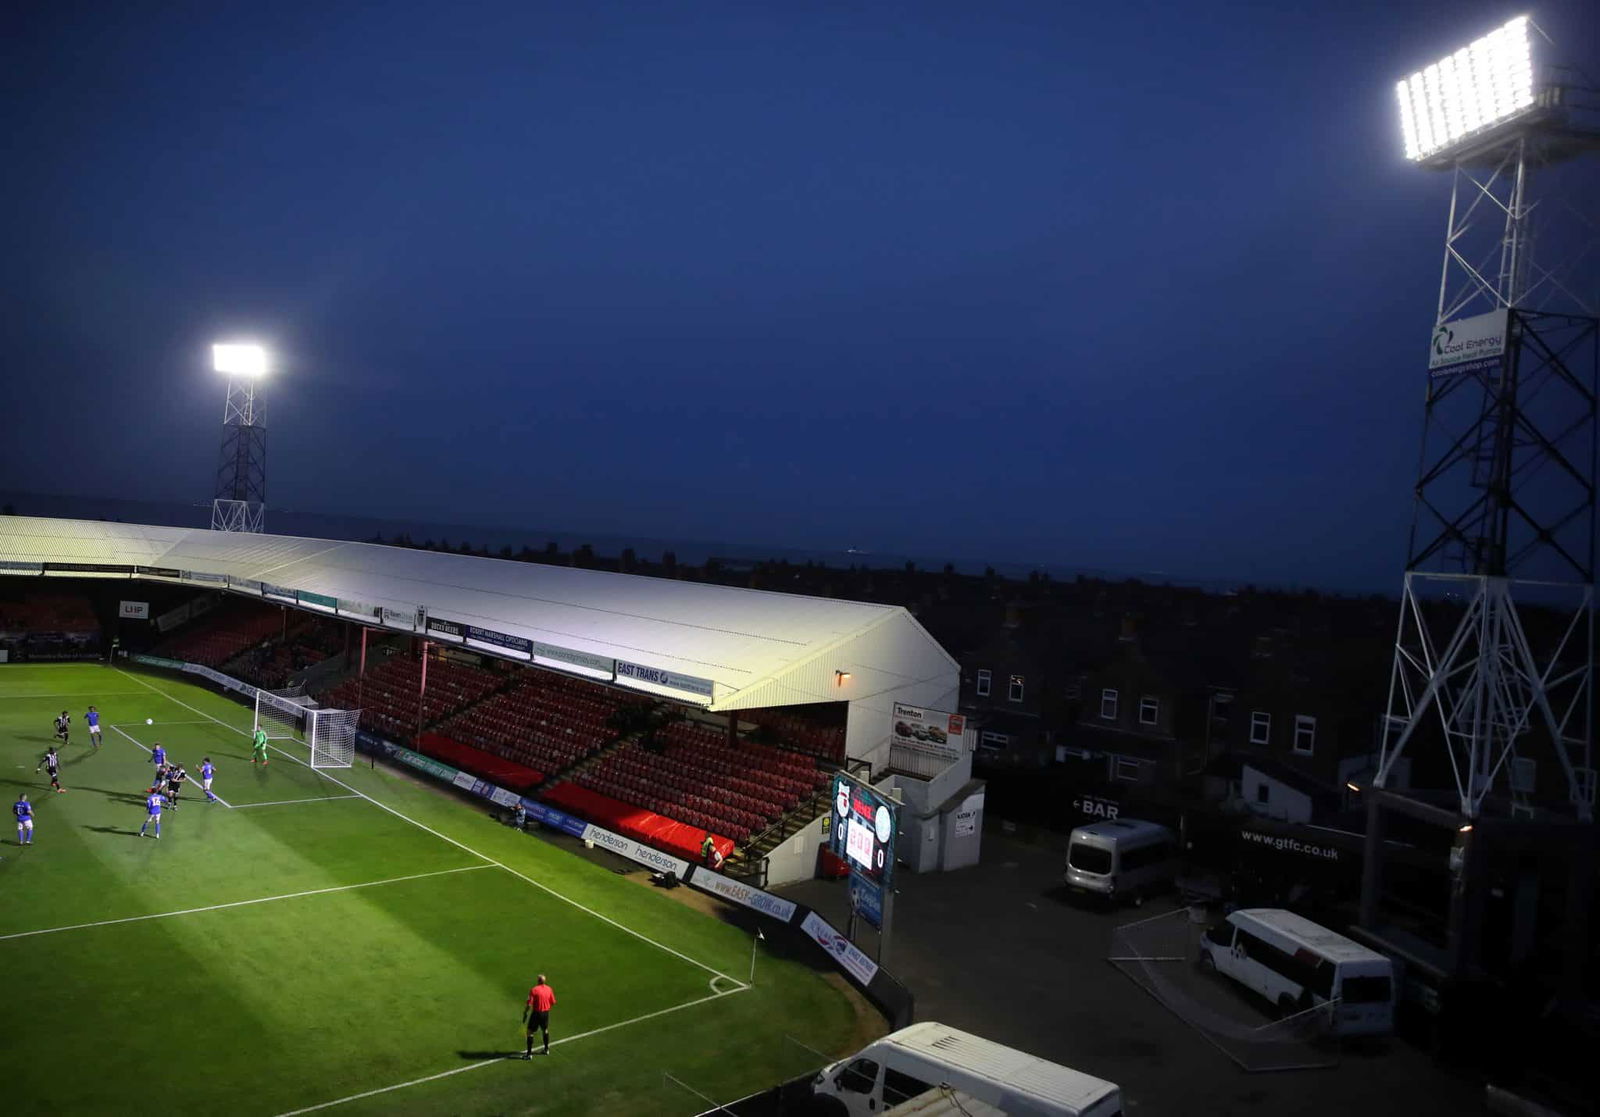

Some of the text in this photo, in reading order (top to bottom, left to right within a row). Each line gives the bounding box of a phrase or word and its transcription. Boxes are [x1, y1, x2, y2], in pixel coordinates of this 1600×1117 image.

[1466, 337, 1501, 349] Energy
[617, 662, 635, 675] EAST
[636, 666, 660, 682] TRANS
[896, 706, 922, 718] Trenton
[1082, 800, 1119, 820] BAR
[838, 823, 844, 841] 0
[589, 827, 677, 871] henderson henderson
[1241, 830, 1339, 860] www.gtfc.co.uk
[877, 849, 884, 868] 0
